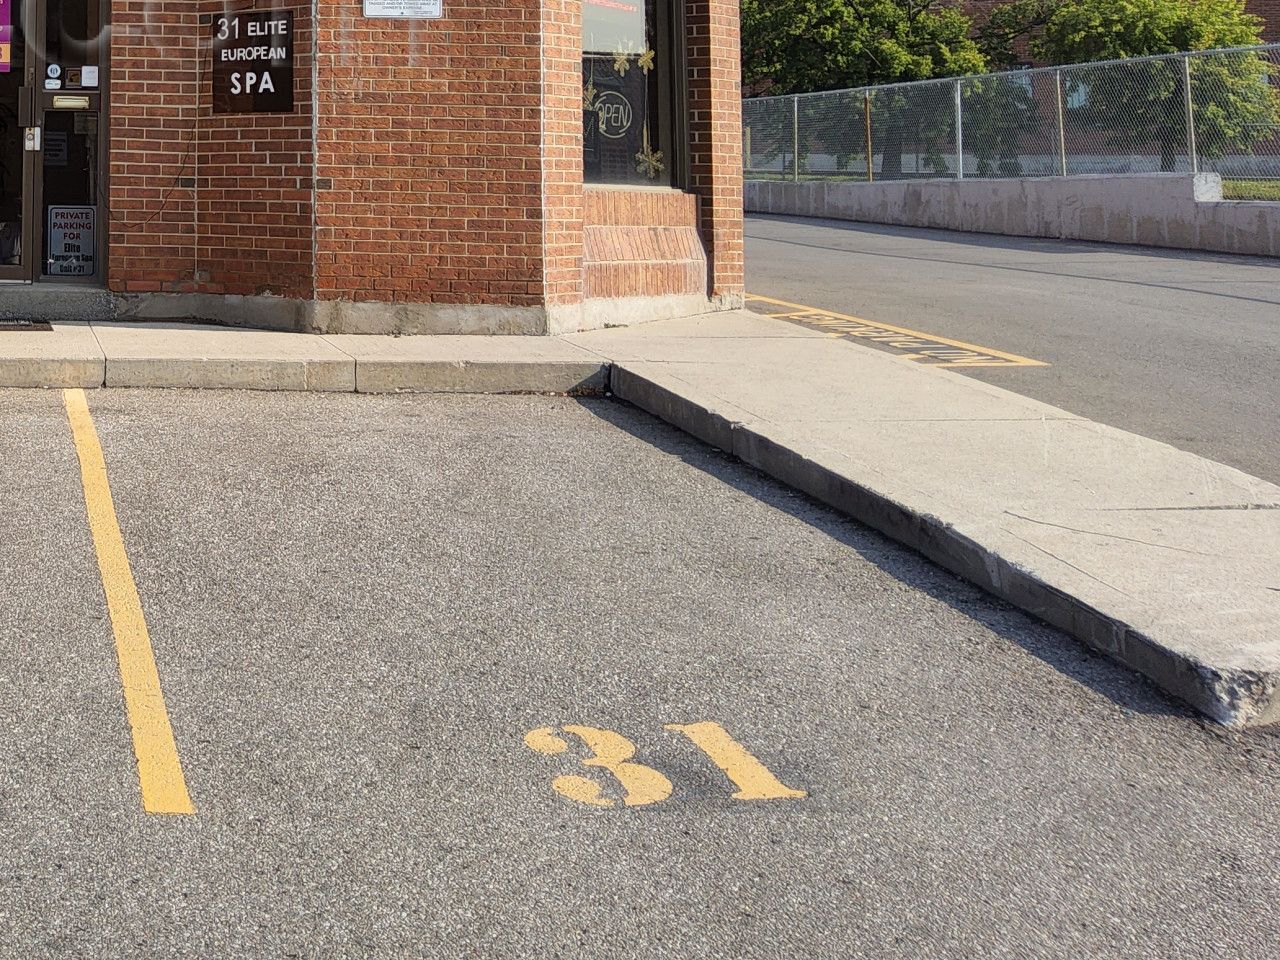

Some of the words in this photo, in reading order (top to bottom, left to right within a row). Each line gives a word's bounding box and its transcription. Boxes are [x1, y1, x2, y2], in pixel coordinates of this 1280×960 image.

[217, 17, 240, 40] 31
[247, 20, 288, 36] ELITE
[221, 46, 286, 61] EUROPEAN
[230, 71, 275, 95] SPA
[55, 211, 91, 220] PRIVATE
[52, 222, 92, 230] PARKING
[63, 232, 81, 240] FOR
[64, 243, 81, 253] Elite
[523, 720, 808, 807] 31
